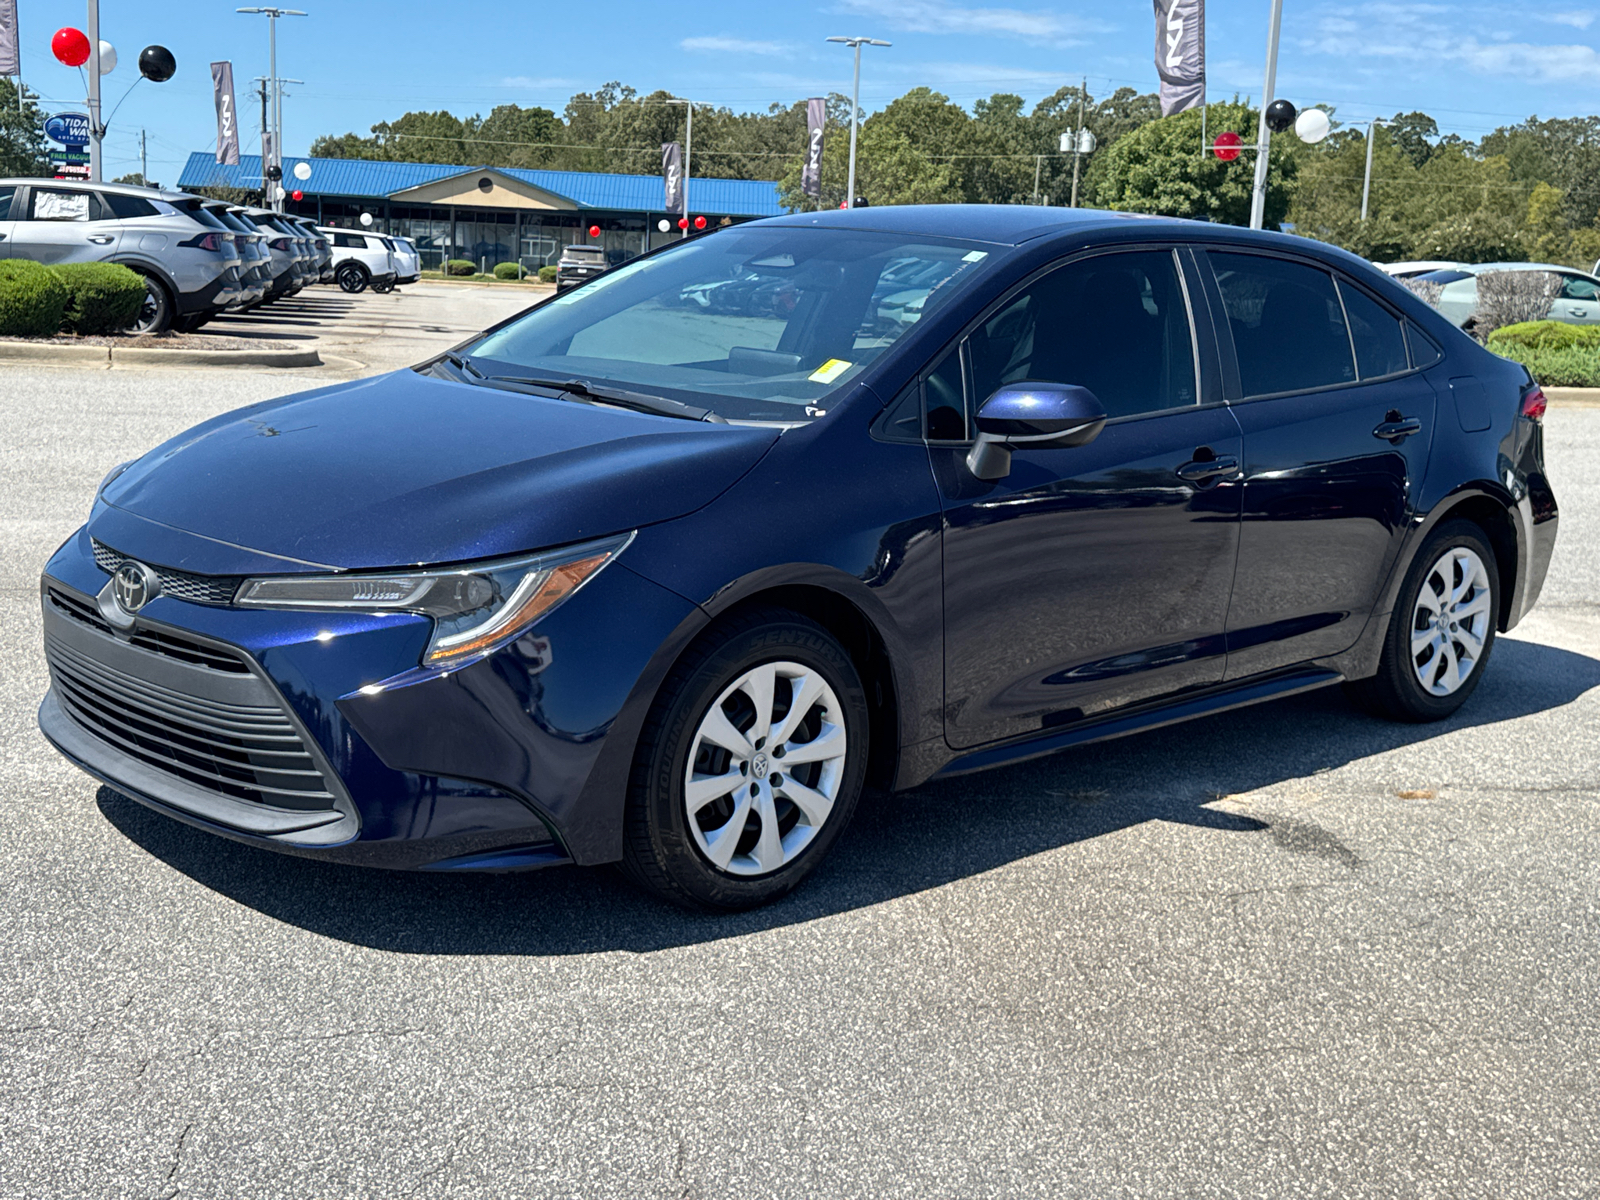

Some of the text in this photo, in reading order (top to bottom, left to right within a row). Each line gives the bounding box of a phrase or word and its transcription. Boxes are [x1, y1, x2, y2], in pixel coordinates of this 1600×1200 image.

[65, 118, 88, 128] TIDA
[751, 630, 848, 669] SENTURY
[658, 705, 691, 802] TOURING
